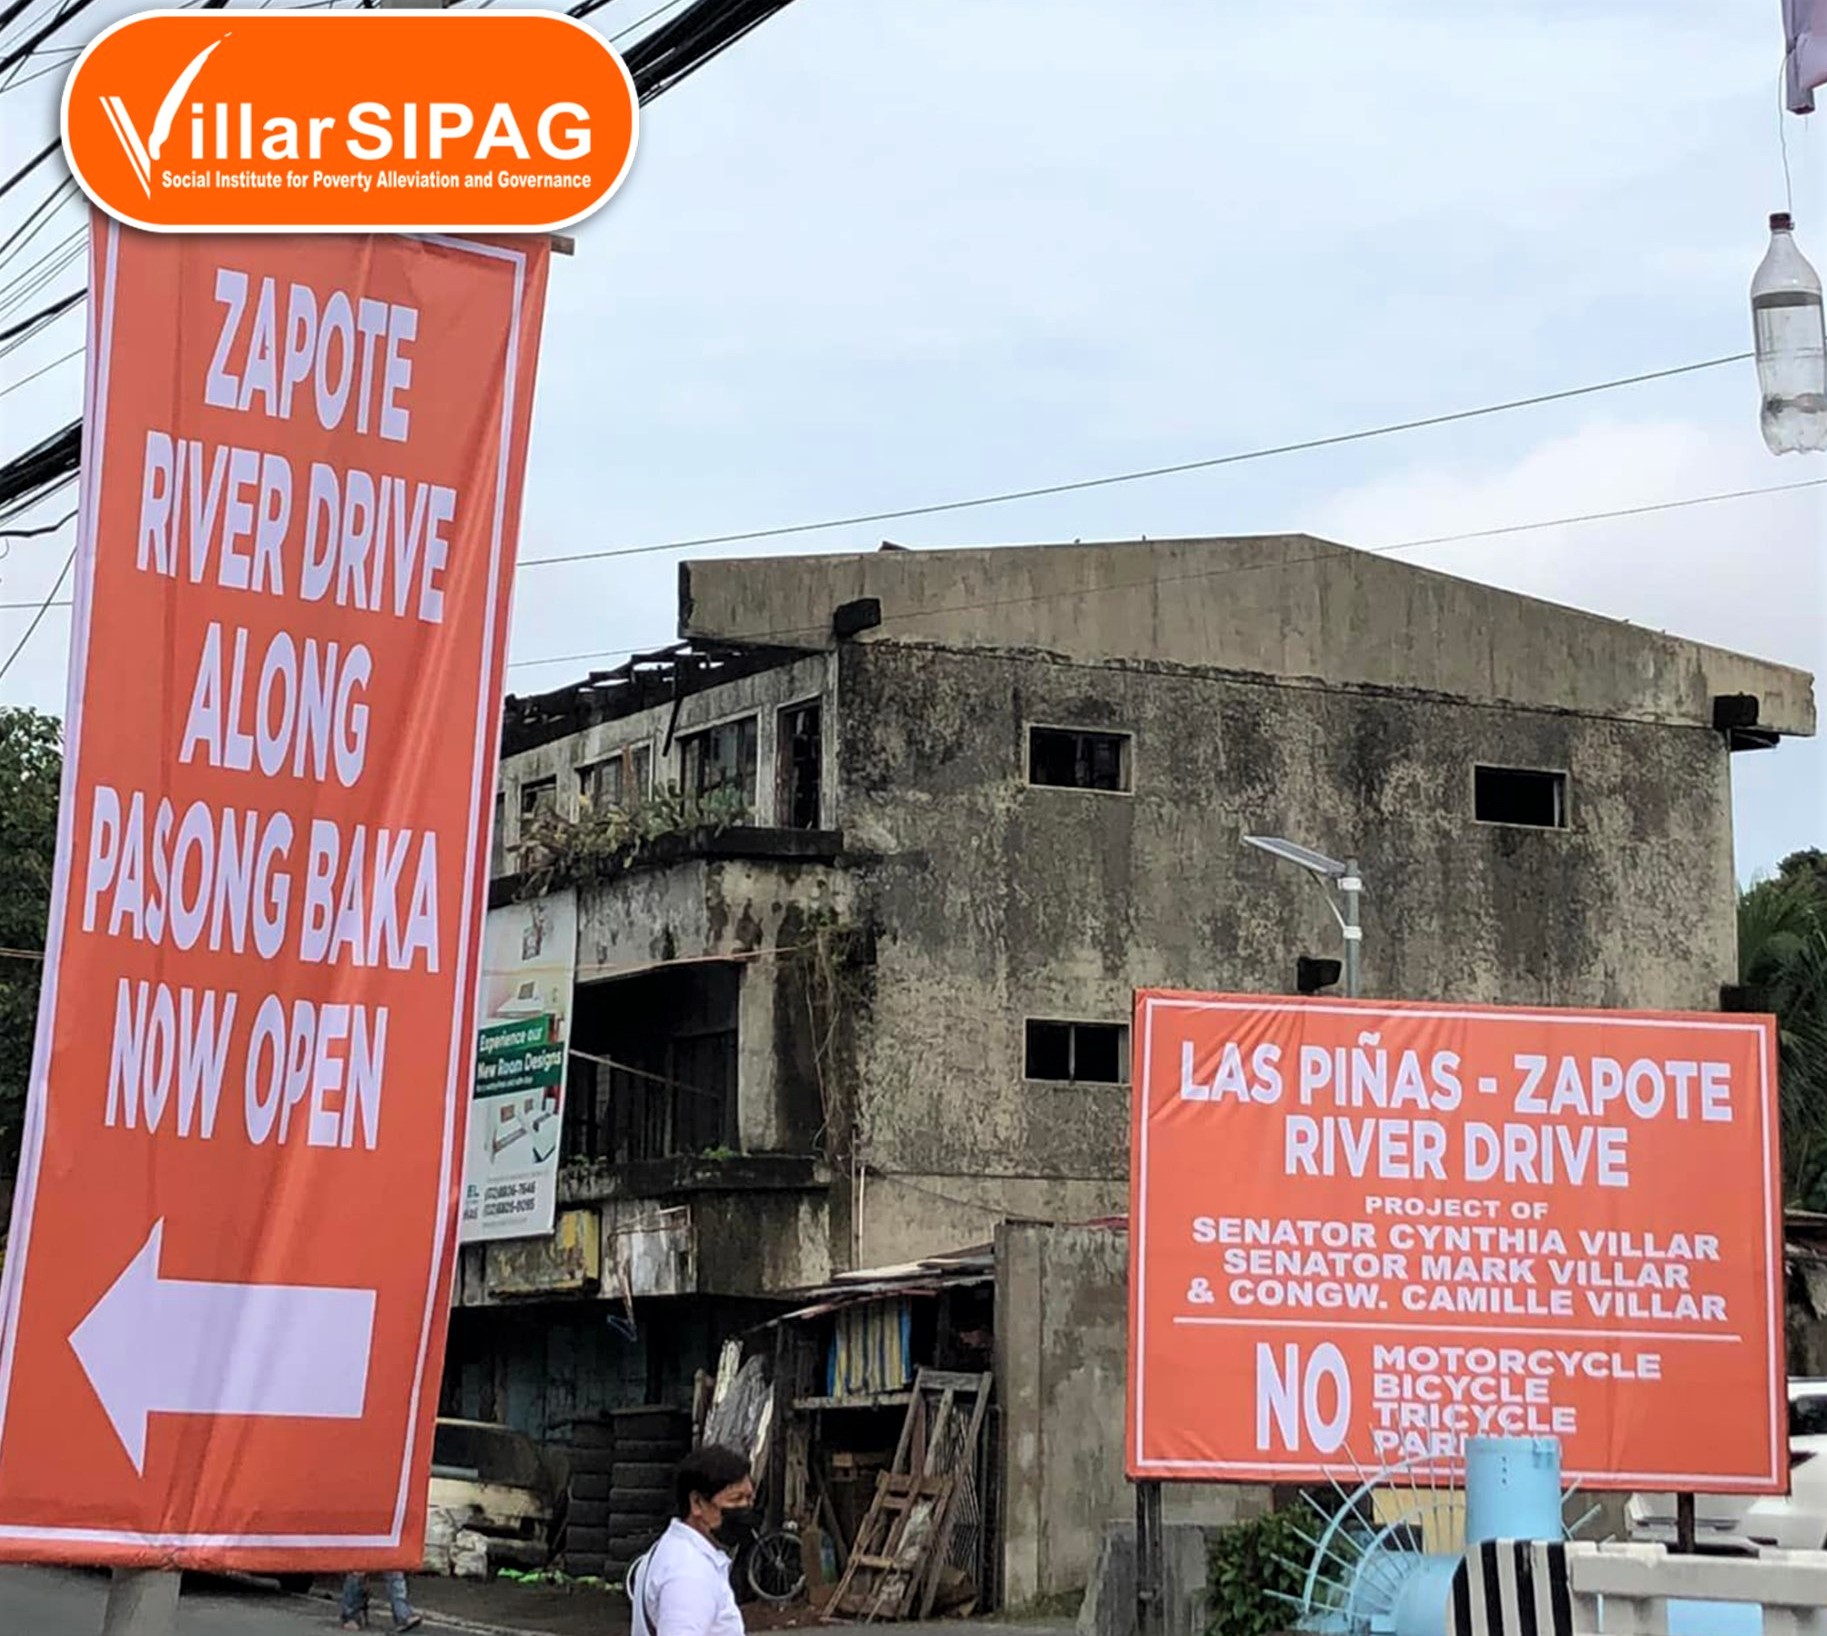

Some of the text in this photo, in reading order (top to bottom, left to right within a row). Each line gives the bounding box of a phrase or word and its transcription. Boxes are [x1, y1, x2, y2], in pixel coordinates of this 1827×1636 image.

[204, 268, 418, 442] ZAPOTE
[137, 431, 456, 624] RIVER DRIVE
[179, 622, 372, 787] ALONG
[83, 786, 439, 973] PASONG BAKA
[105, 978, 388, 1150] NOW OPEN
[524, 1049, 562, 1072] Designs
[1180, 1041, 1283, 1104] LAS
[1300, 1031, 1462, 1112] PIÑAS
[1512, 1054, 1733, 1122] ZAPOTE
[1285, 1115, 1629, 1187] RIVER DRIVE
[1365, 1196, 1549, 1220] PROJECT OF
[1192, 1216, 1720, 1261] SENATOR CYNTHIA VILLAR
[1223, 1248, 1690, 1288] SENATOR MARK VILLAR
[1187, 1277, 1728, 1321] & CONGW. CAMILLE VILLAR
[1373, 1344, 1662, 1380] MOTORCYCLE
[1373, 1373, 1550, 1404] BICYCLE
[1256, 1342, 1351, 1454] NO
[1372, 1401, 1578, 1433] TRICYCLE
